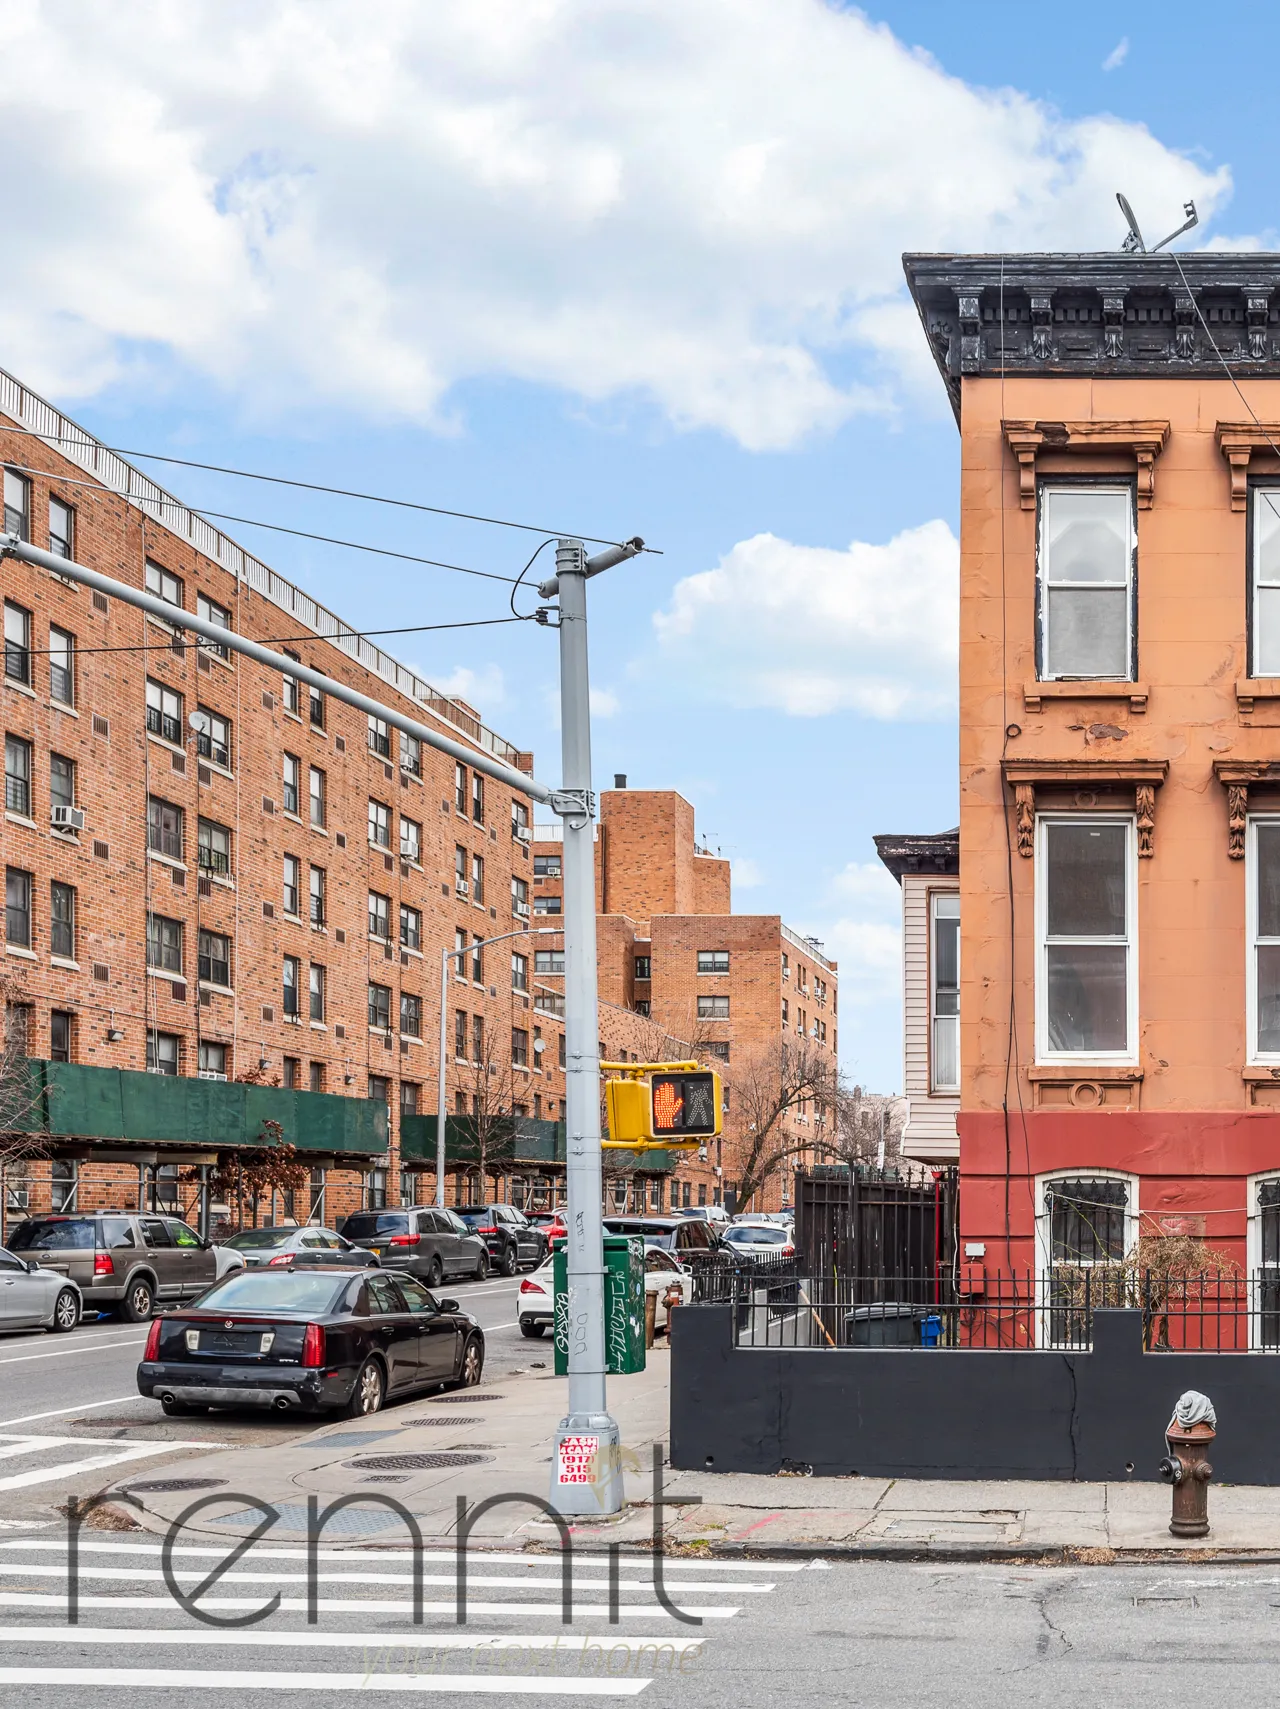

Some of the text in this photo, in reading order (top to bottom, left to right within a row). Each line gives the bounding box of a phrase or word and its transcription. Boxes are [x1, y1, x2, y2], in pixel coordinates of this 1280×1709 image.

[562, 1455, 595, 1464] (917)
[566, 1465, 592, 1473] 515
[560, 1474, 597, 1483] 6499
